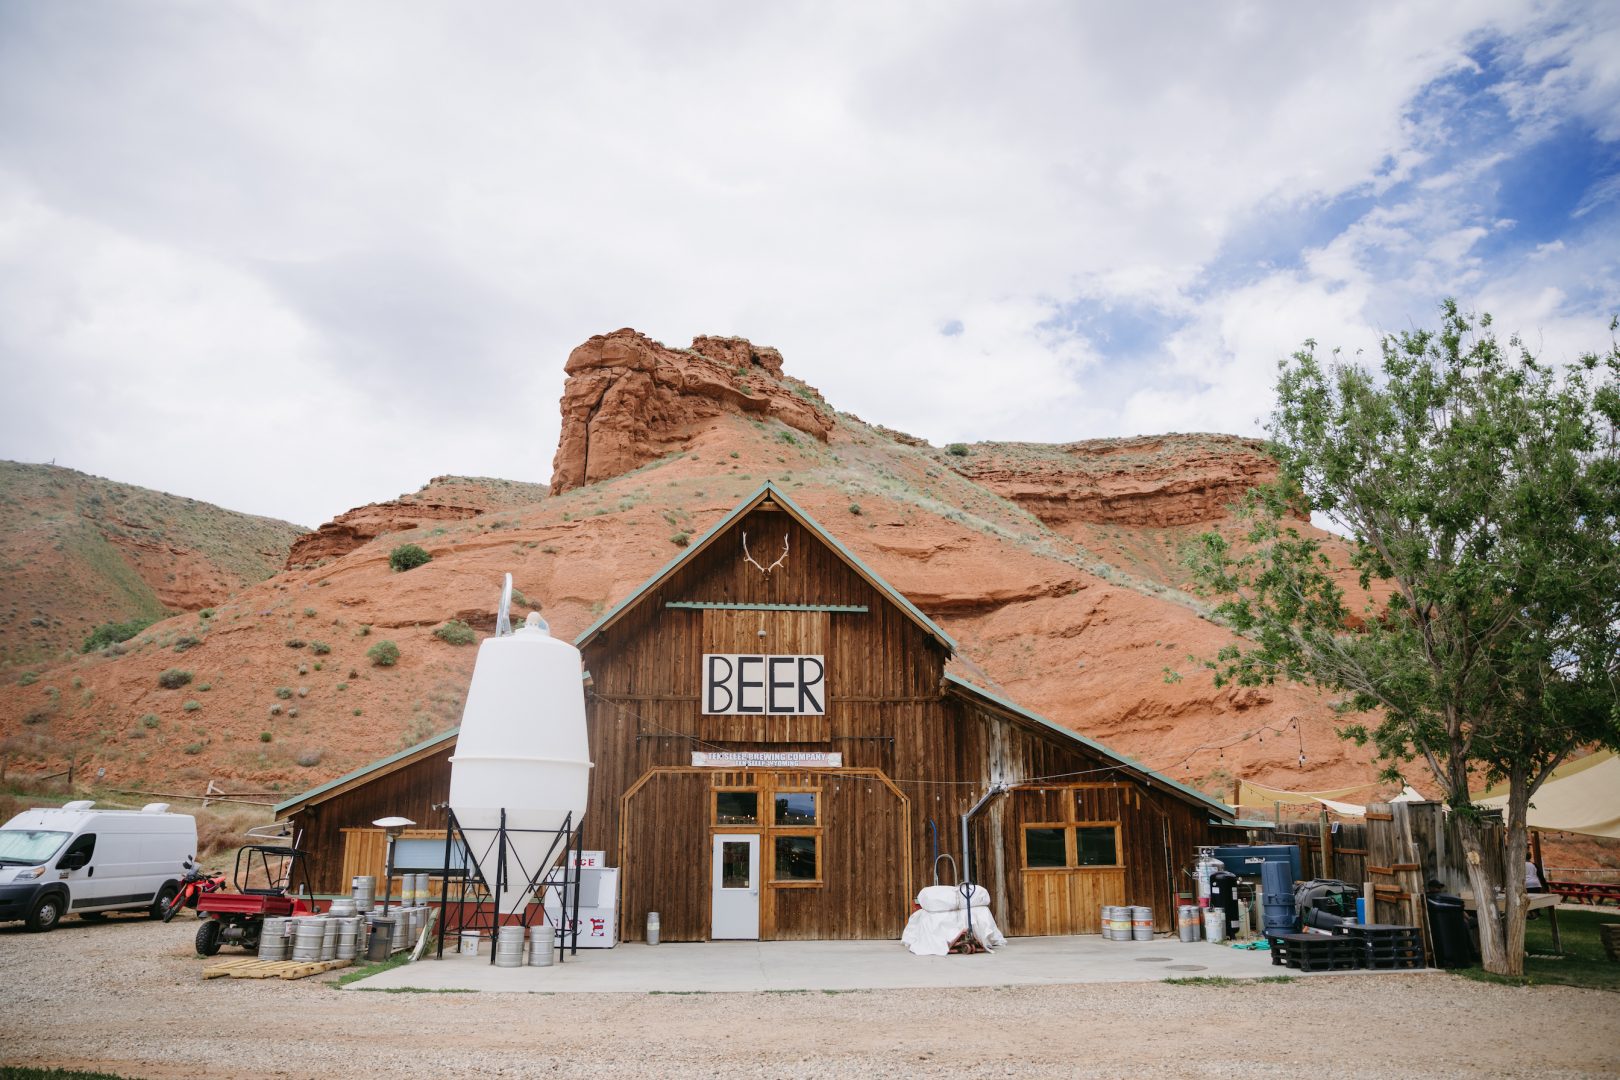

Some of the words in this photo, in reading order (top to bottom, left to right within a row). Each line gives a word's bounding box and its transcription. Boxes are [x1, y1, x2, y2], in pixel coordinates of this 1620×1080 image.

[708, 656, 824, 713] BEER
[724, 752, 747, 760] SLEEP
[749, 752, 786, 761] BREWING
[787, 752, 826, 761] COMPANY
[574, 858, 595, 867] ICE
